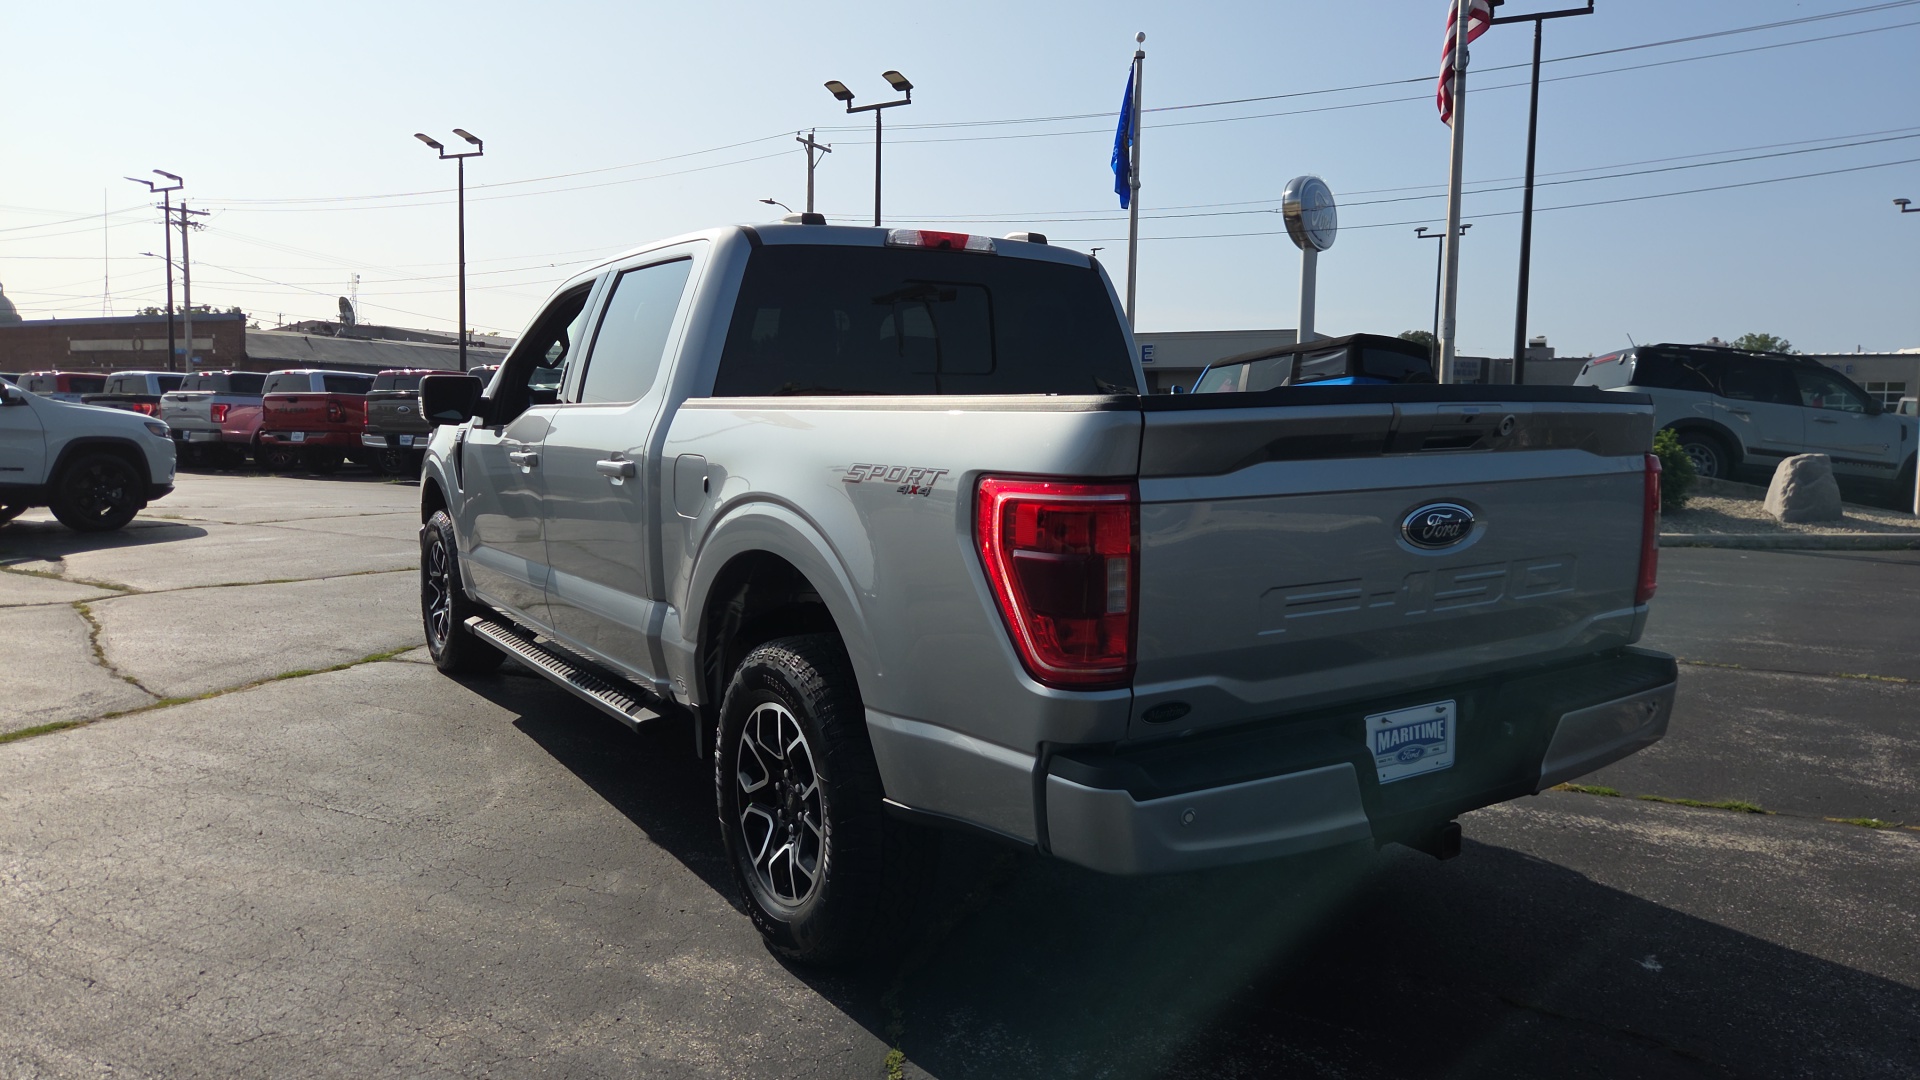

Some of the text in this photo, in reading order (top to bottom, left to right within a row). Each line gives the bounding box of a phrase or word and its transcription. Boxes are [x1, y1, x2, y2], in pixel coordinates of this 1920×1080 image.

[842, 463, 949, 486] SPORT
[1422, 513, 1462, 539] Ford
[1258, 553, 1577, 635] F-150
[1377, 720, 1444, 753] MARITIME
[1401, 749, 1420, 761] Ford
